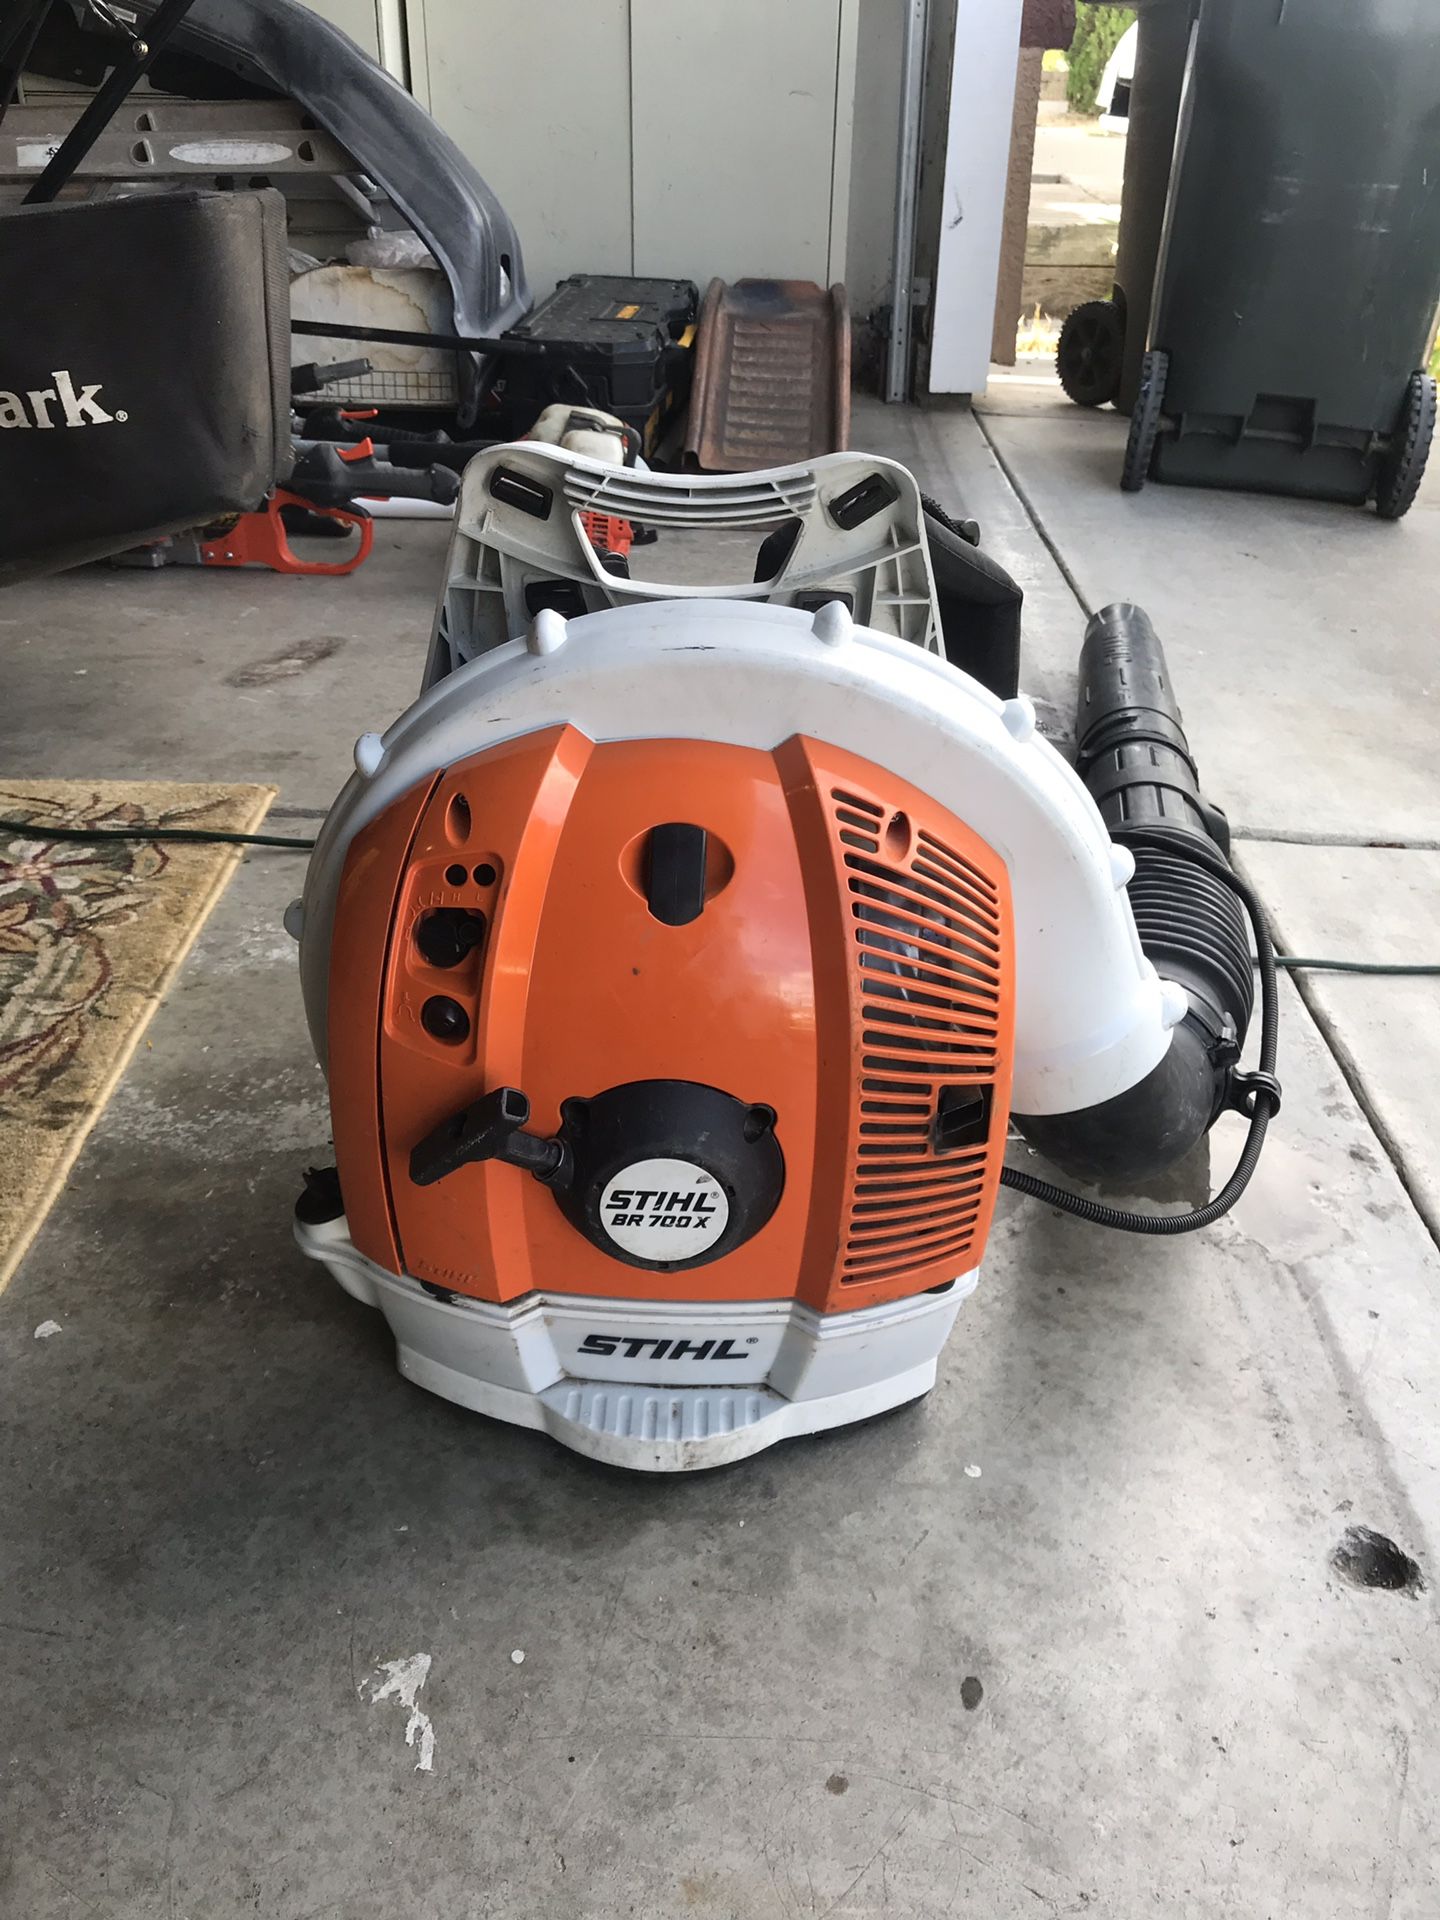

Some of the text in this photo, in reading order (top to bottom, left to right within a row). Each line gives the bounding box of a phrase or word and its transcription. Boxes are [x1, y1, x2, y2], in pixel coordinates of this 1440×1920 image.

[611, 1214, 711, 1229] BR 700 X
